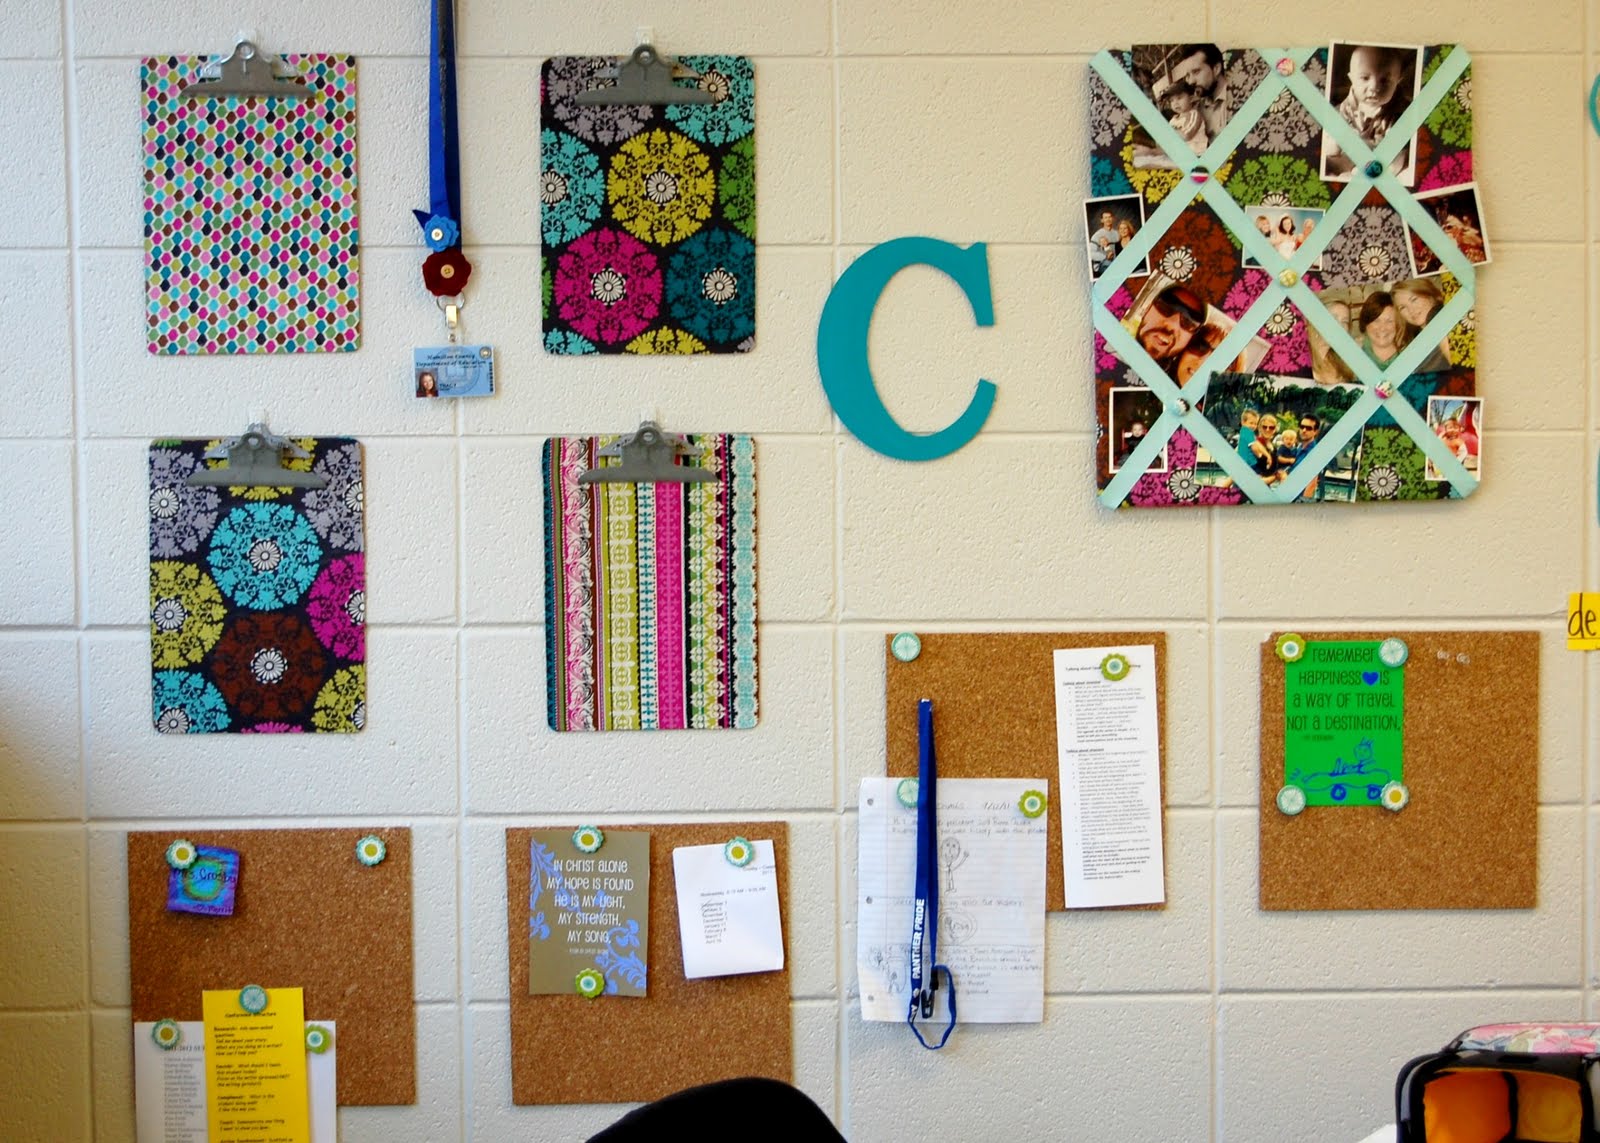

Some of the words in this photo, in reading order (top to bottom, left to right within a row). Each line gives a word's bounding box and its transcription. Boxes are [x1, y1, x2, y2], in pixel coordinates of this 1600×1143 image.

[816, 236, 997, 462] C
[1568, 592, 1596, 639] de
[1380, 670, 1390, 685] IS
[1293, 693, 1301, 708] a
[1337, 693, 1352, 708] OF
[1286, 715, 1306, 730] NOT
[1312, 715, 1320, 730] a
[553, 860, 562, 871] IN
[546, 878, 561, 889] MY
[592, 878, 601, 890] IS
[604, 878, 633, 891] FOUND
[570, 895, 579, 907] IS
[582, 895, 596, 907] MY
[558, 913, 572, 925] MY
[914, 898, 925, 933] PRIDE
[567, 931, 582, 942] MY
[912, 932, 923, 980] PANTHER
